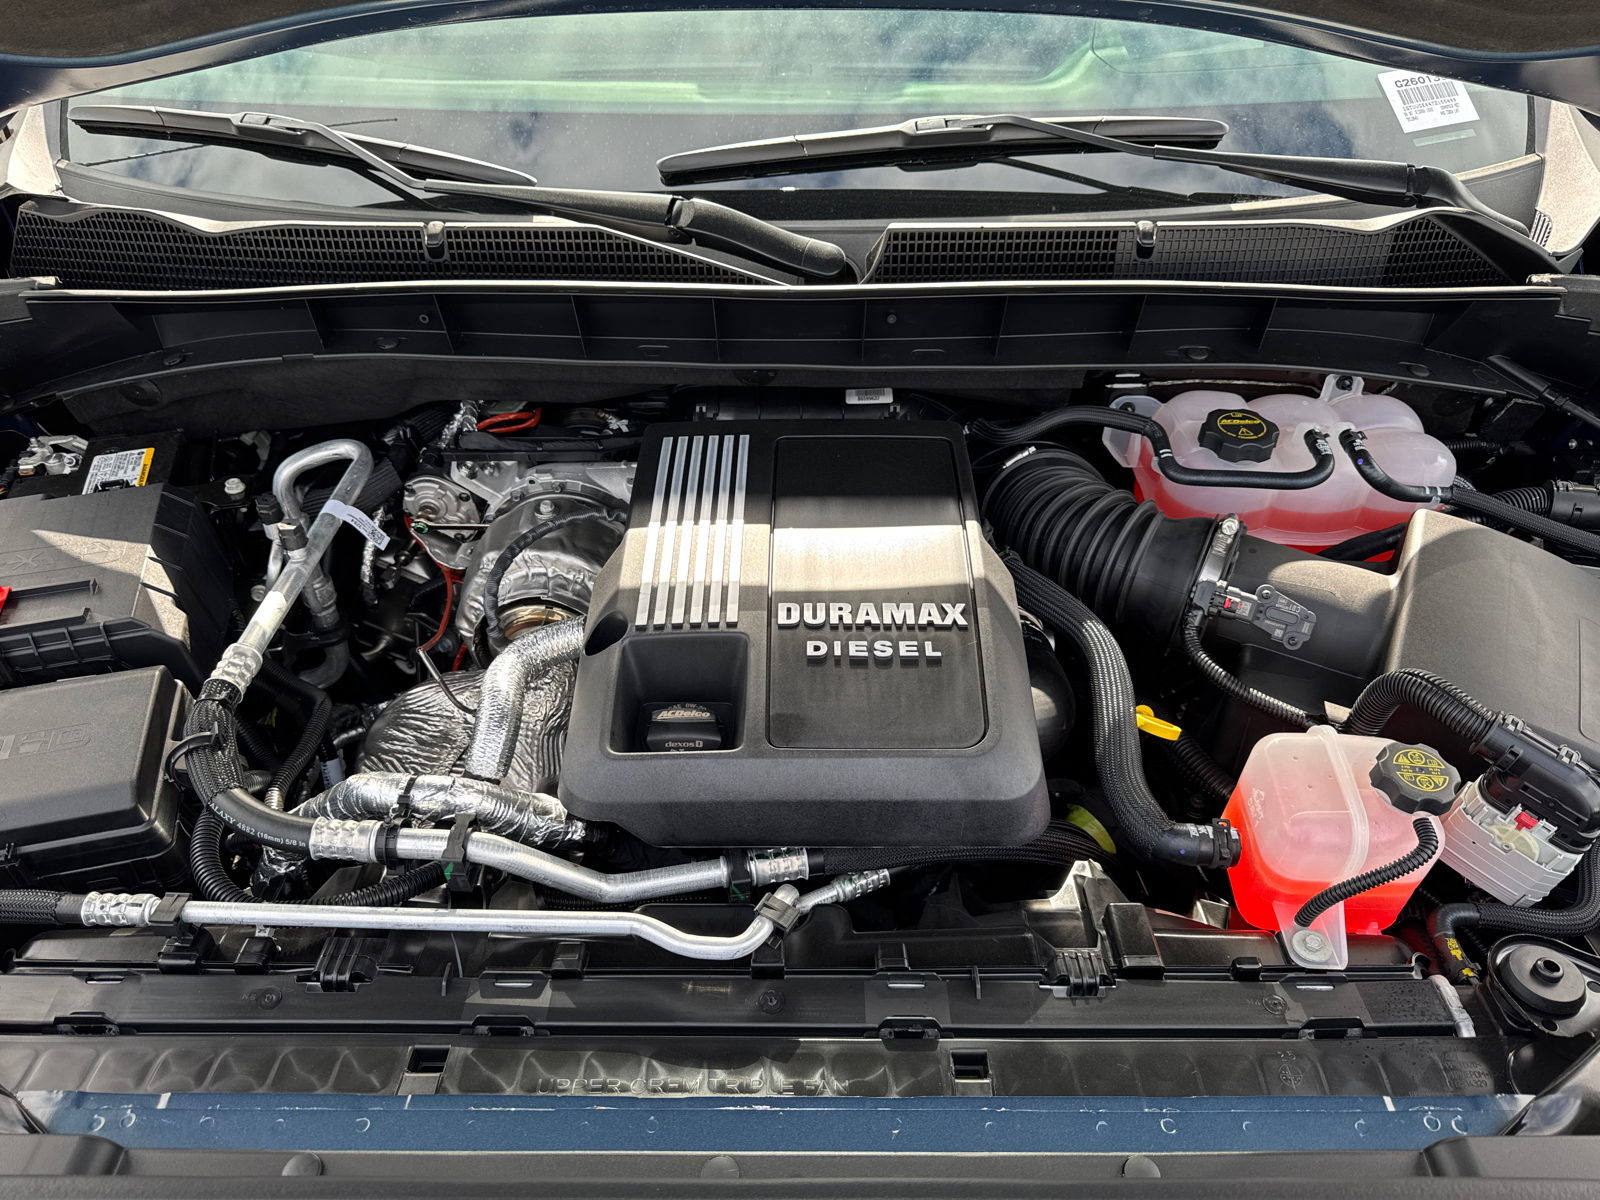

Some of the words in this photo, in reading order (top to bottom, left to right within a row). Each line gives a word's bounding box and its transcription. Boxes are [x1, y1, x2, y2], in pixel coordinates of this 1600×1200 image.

[777, 602, 969, 627] DURAMAX
[806, 640, 942, 659] DIESEL
[656, 710, 711, 719] ACDelco
[208, 802, 236, 825] ALAXY
[236, 822, 255, 836] 4882
[257, 831, 284, 844] (16mm)
[285, 838, 298, 847] 5/8
[536, 1078, 622, 1095] UPPER
[708, 1078, 795, 1095] TRIPLE
[803, 1079, 849, 1096] FAN
